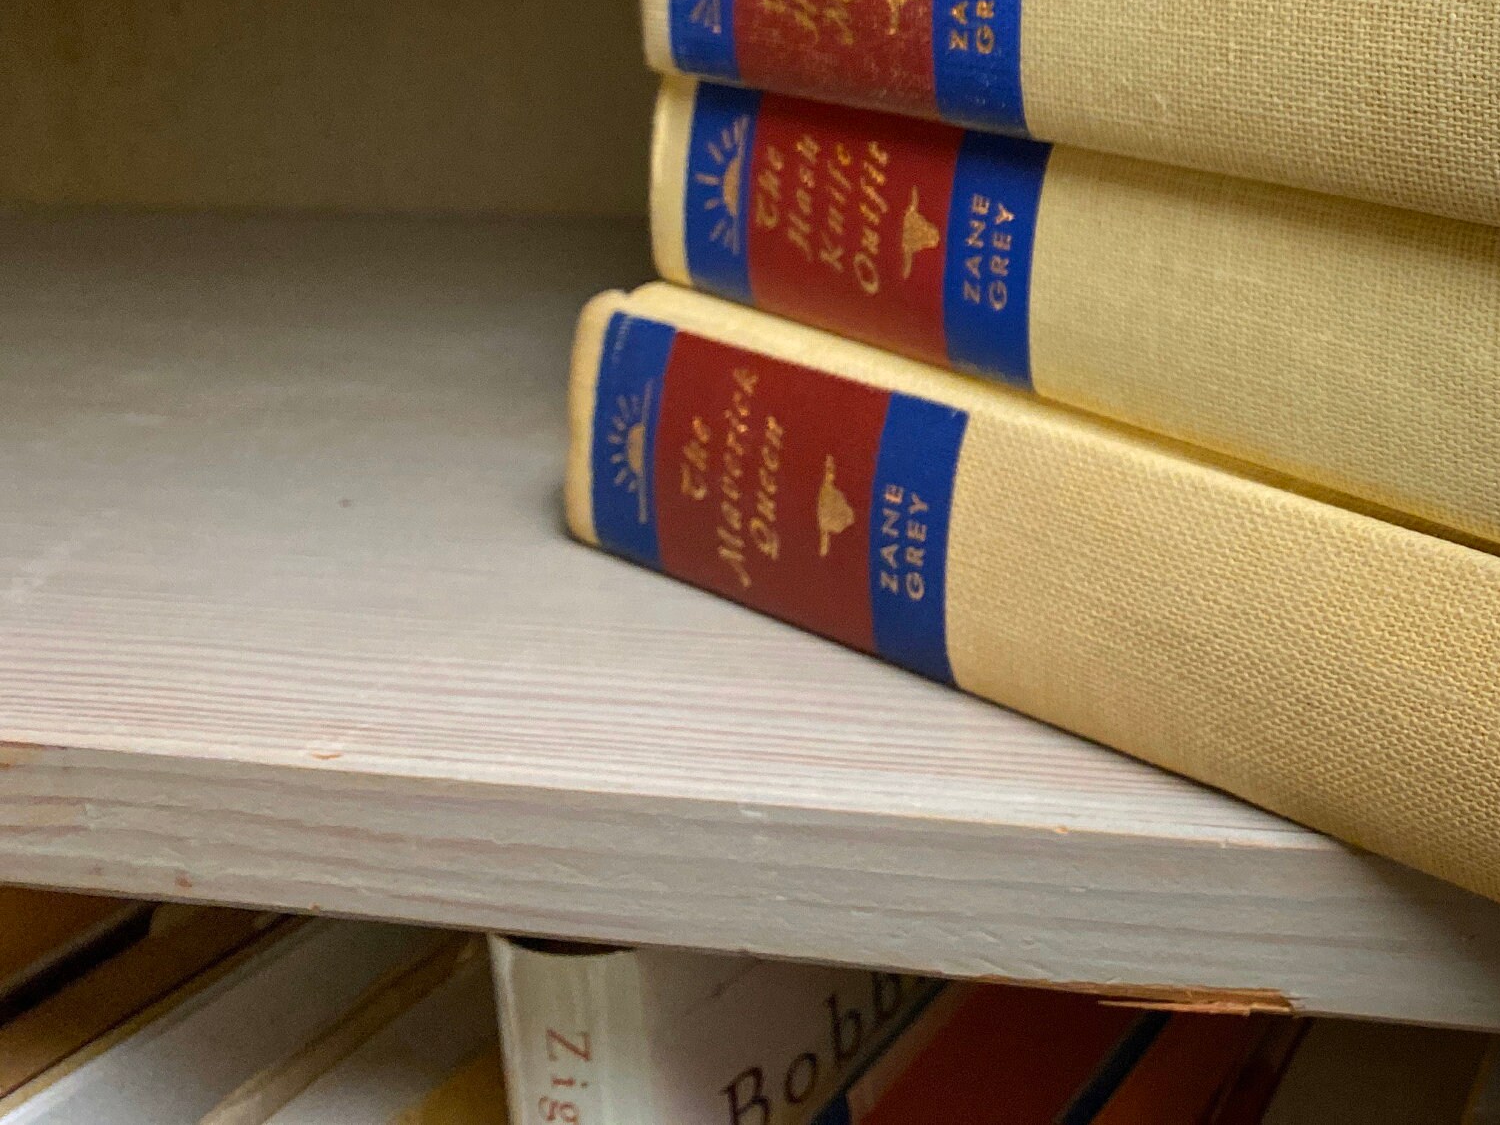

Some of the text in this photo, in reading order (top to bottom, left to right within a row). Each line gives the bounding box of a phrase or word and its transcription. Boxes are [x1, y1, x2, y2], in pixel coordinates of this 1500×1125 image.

[756, 145, 784, 229] The
[787, 135, 820, 263] Hash
[819, 142, 851, 273] Knife
[853, 141, 889, 295] Outfit
[963, 193, 990, 305] ZANE
[988, 203, 1015, 311] GREY
[680, 415, 711, 501] The
[717, 367, 759, 587] Maverick
[750, 415, 784, 560] Queen
[880, 483, 904, 595] ZANE
[905, 492, 928, 601] GREY
